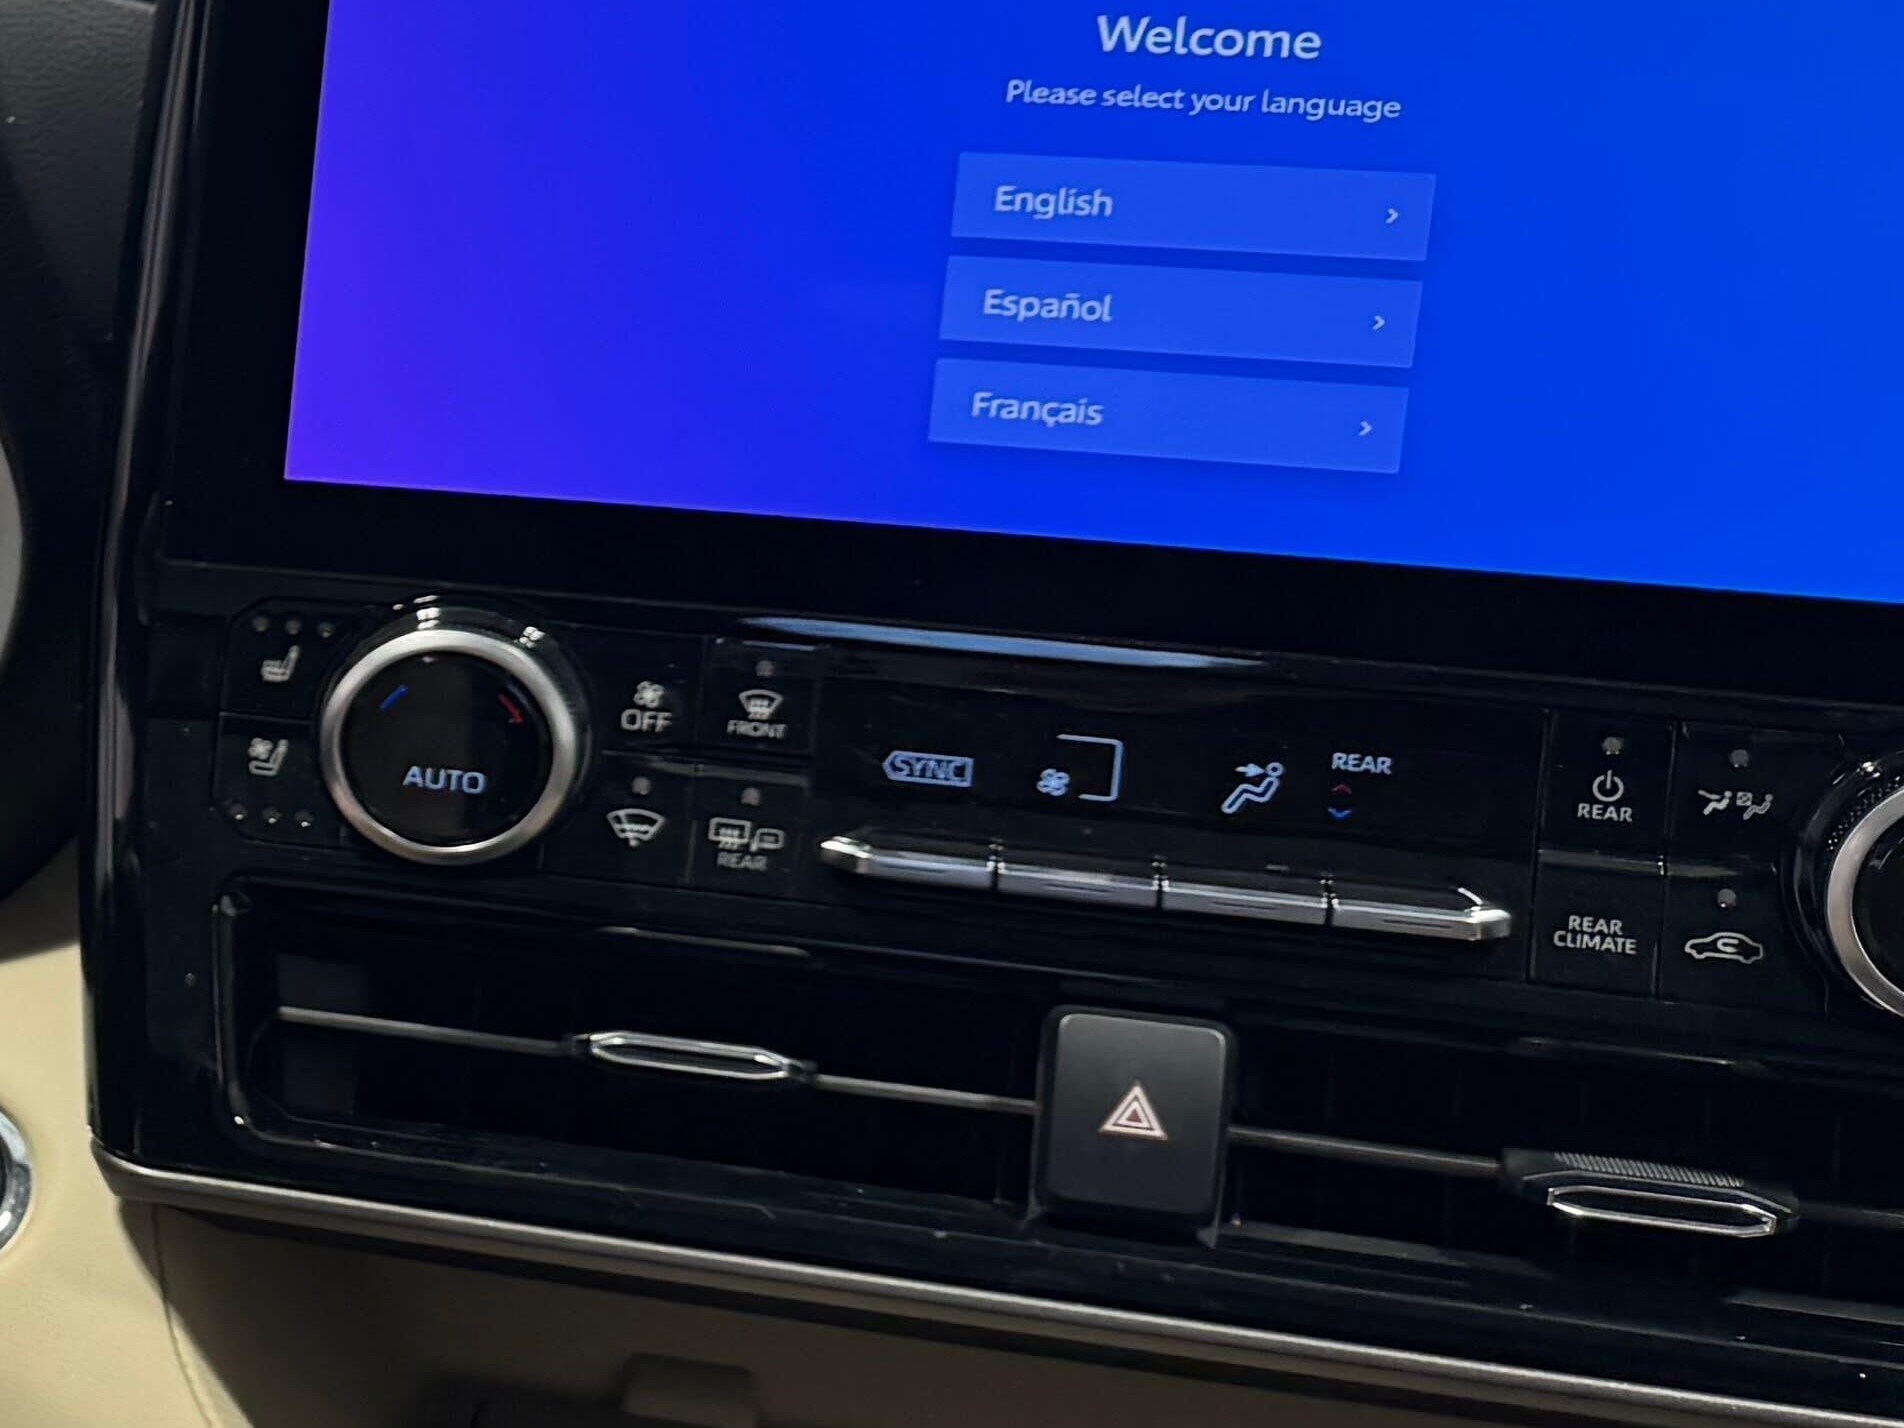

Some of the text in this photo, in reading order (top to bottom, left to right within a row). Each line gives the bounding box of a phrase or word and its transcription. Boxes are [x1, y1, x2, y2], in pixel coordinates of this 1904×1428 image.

[1096, 14, 1322, 60] Welcome
[1005, 78, 1402, 124] Please select your language
[993, 185, 1114, 220] English
[983, 288, 1113, 322] Español
[971, 391, 1105, 428] Français
[620, 708, 673, 733] OFF
[726, 719, 788, 740] FRONT
[891, 755, 969, 783] SYNC
[1331, 752, 1393, 775] REAR
[402, 765, 489, 795] AUTO
[1576, 802, 1633, 822] REAR
[716, 851, 768, 871] REAR
[1567, 914, 1623, 936] REAR
[1552, 929, 1638, 955] CLIMATE
